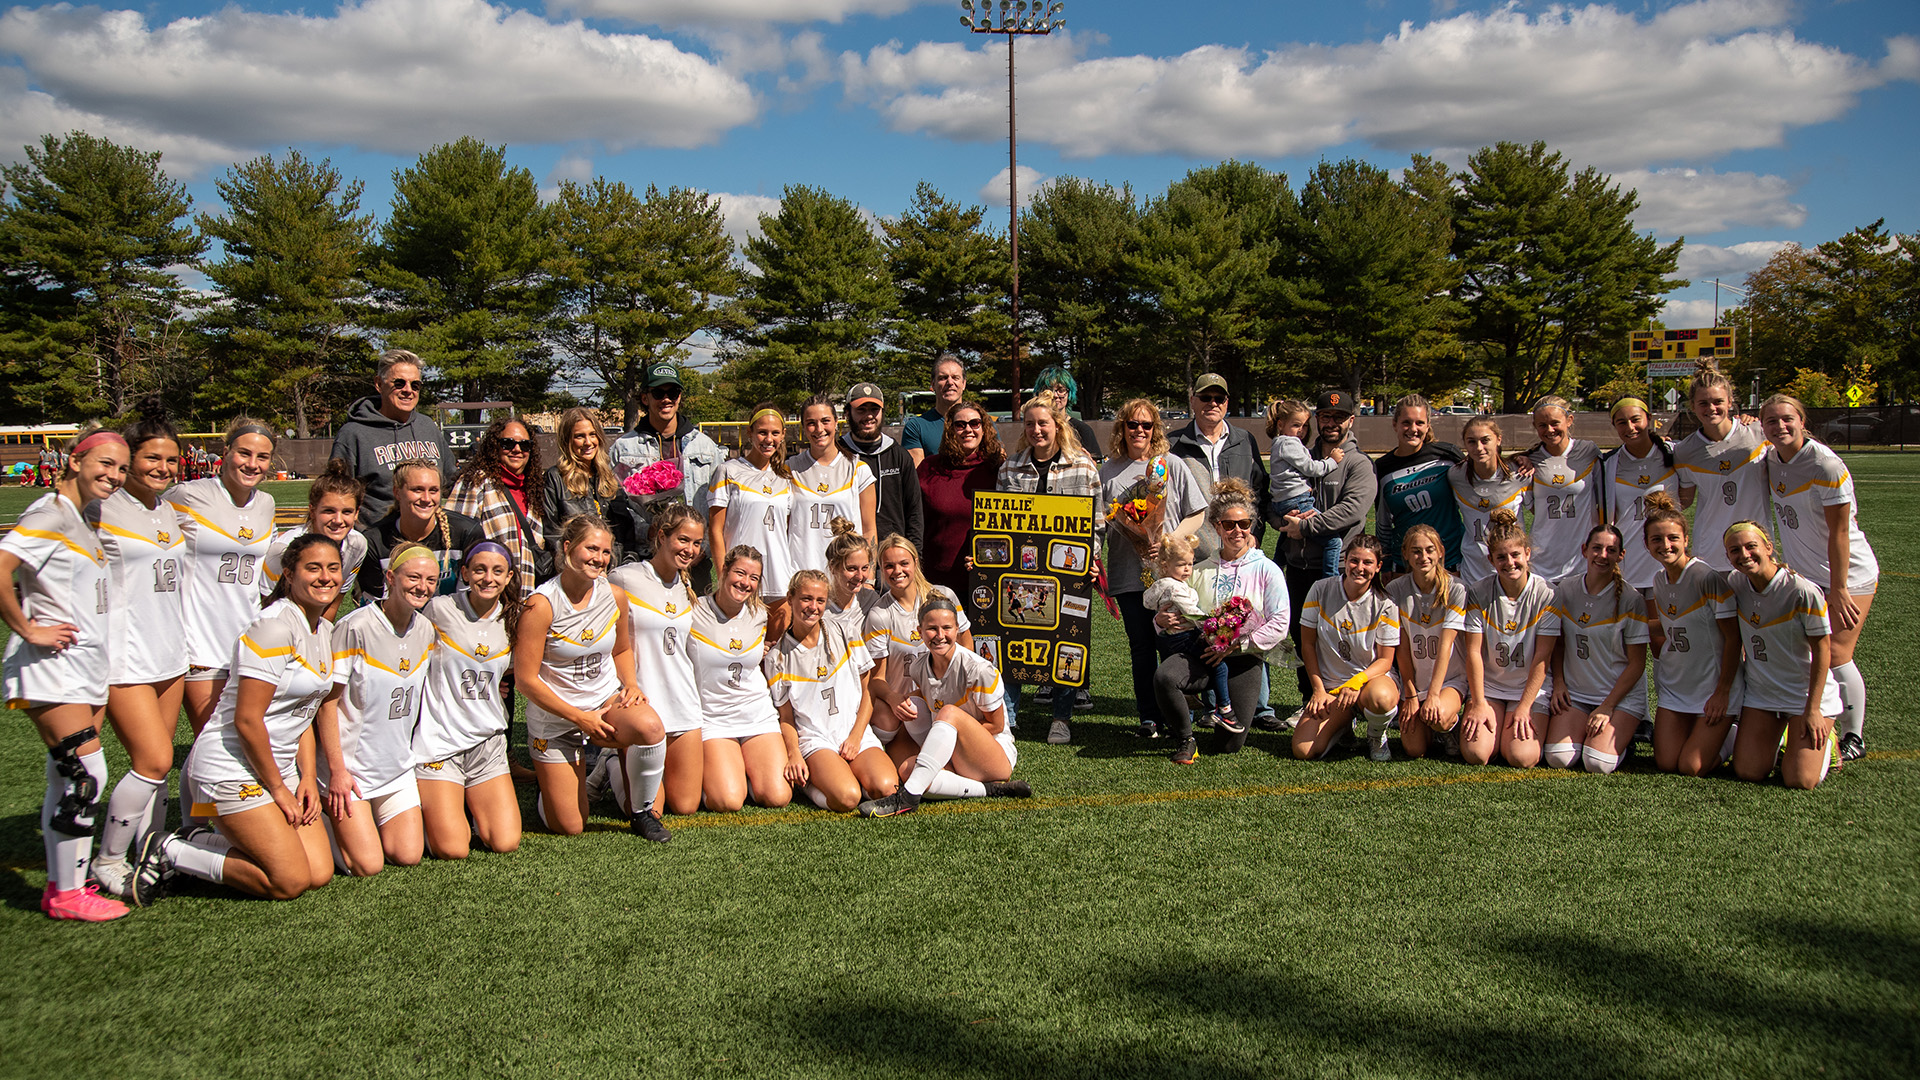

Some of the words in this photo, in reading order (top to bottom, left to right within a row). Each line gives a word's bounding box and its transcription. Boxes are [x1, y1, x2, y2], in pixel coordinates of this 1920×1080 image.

[1674, 329, 1698, 340] 1:45
[374, 440, 440, 465] ROWAN
[1391, 473, 1439, 495] Rowan
[1721, 481, 1737, 506] 9
[975, 497, 1032, 511] NATALIE
[1404, 490, 1432, 512] 00
[1546, 493, 1576, 520] 24
[763, 505, 775, 531] 4
[810, 503, 835, 529] 17
[974, 512, 1091, 534] PANTALONE
[153, 558, 177, 592] 12
[217, 552, 256, 586] 26
[663, 626, 678, 655] 6
[1010, 640, 1049, 664] #17
[1338, 640, 1351, 661] 8
[1413, 634, 1439, 660] 30
[1575, 633, 1590, 660] 5
[1667, 627, 1690, 653] 15
[1751, 635, 1768, 662] 2
[573, 652, 602, 682] 19
[1495, 642, 1525, 668] 34
[461, 669, 494, 701] 27
[727, 662, 743, 688] 3
[388, 686, 414, 720] 21
[821, 687, 839, 716] 7
